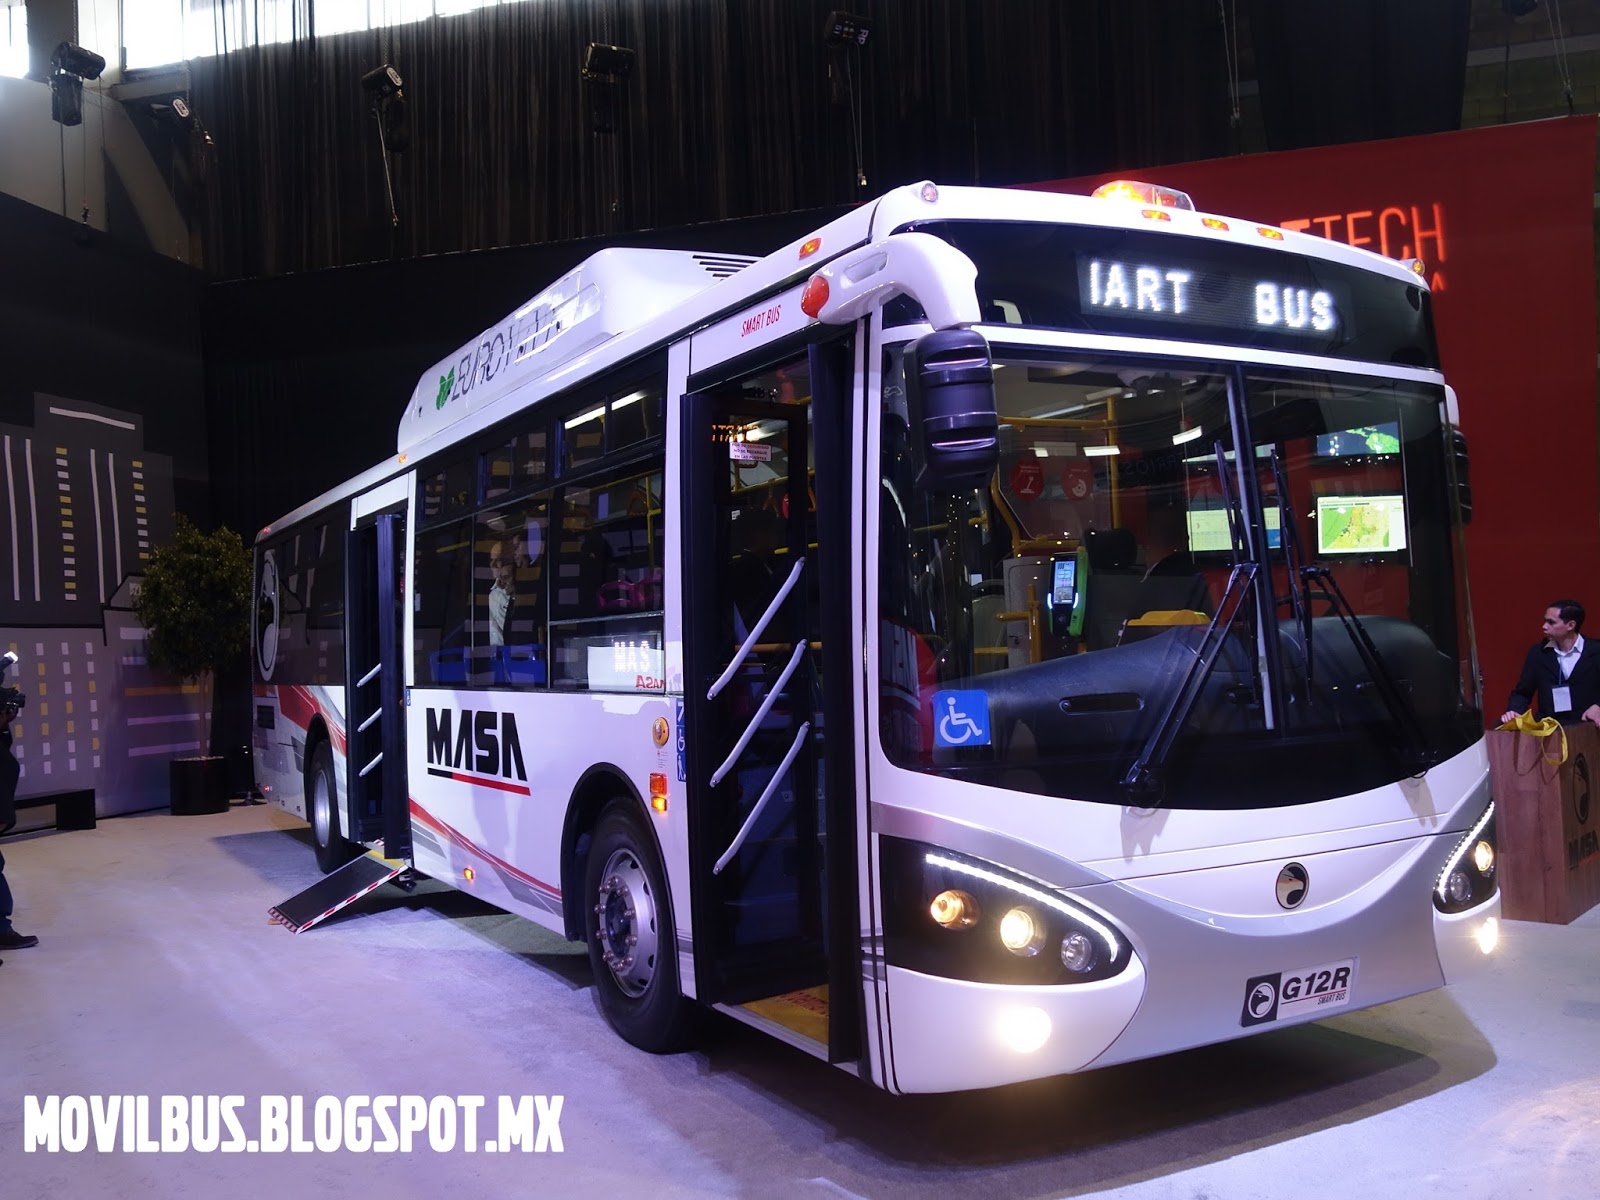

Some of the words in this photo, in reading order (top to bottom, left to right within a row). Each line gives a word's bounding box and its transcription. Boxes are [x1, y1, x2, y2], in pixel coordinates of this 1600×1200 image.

[741, 311, 766, 337] SMART
[766, 304, 782, 327] BUS
[1255, 281, 1334, 331] BUS
[425, 707, 528, 782] MASA
[1568, 830, 1600, 866] MASA
[1282, 966, 1351, 1001] G12R
[1317, 994, 1335, 1005] SMART
[1335, 992, 1346, 1002] BUS
